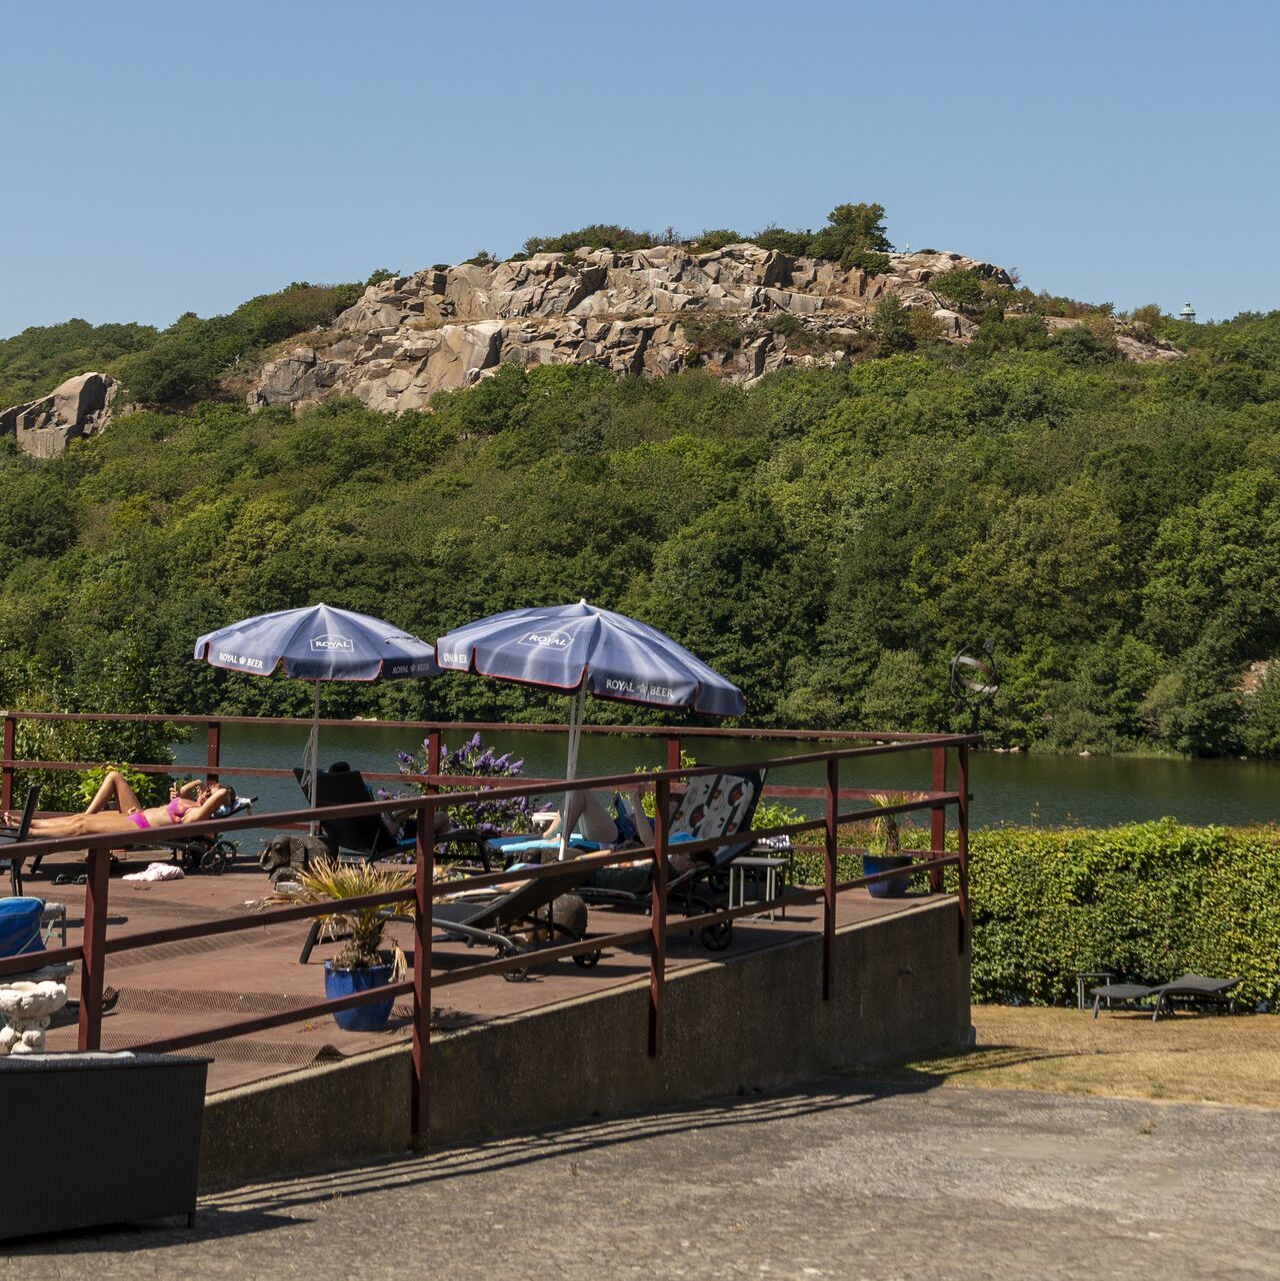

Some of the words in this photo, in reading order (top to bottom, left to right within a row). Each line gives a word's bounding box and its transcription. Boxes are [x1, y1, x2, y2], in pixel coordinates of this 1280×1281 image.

[529, 634, 566, 646] ROYAL
[219, 652, 238, 664] ROYAL
[246, 657, 263, 668] BEER
[606, 678, 635, 693] ROYAL
[650, 686, 674, 699] BEER
